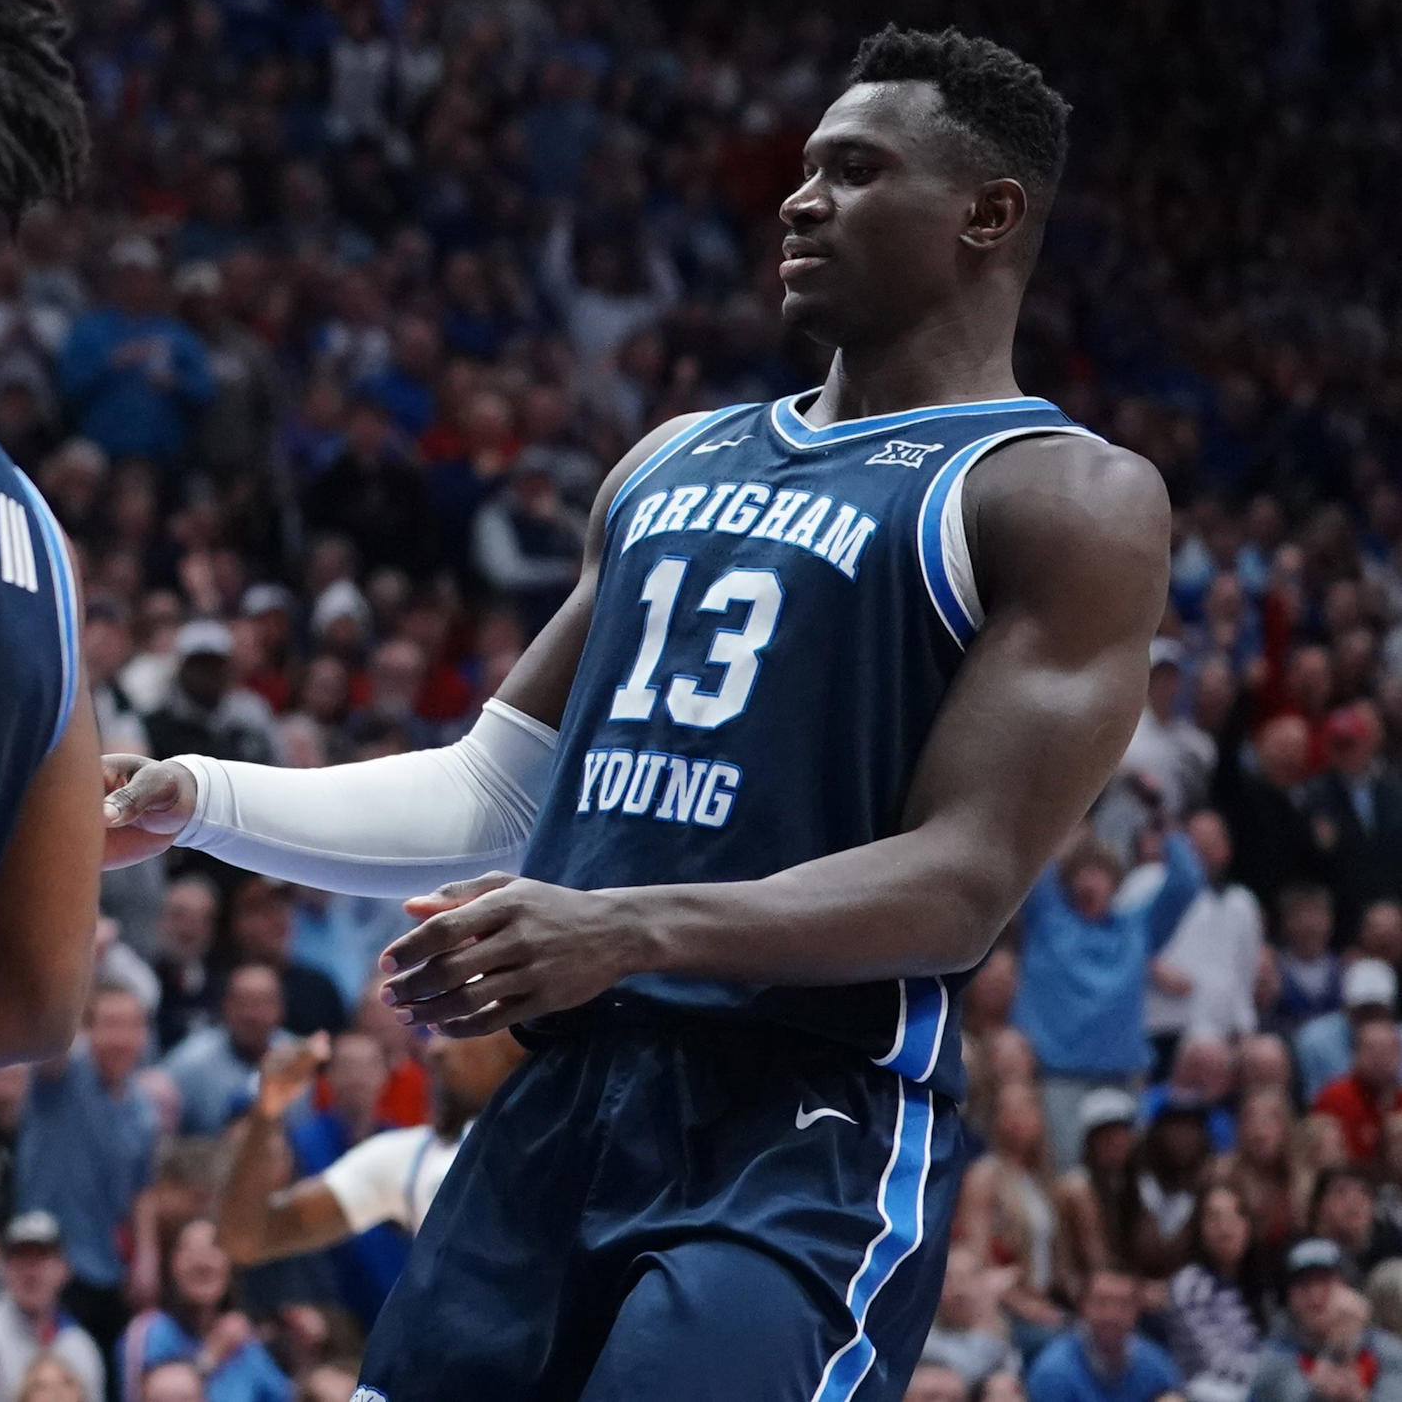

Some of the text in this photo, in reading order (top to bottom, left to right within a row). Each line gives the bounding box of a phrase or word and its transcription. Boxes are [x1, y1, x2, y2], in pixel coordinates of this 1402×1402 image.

[620, 481, 880, 583] BRIGHAM
[608, 554, 786, 730] 13
[576, 748, 743, 829] YOUNG
